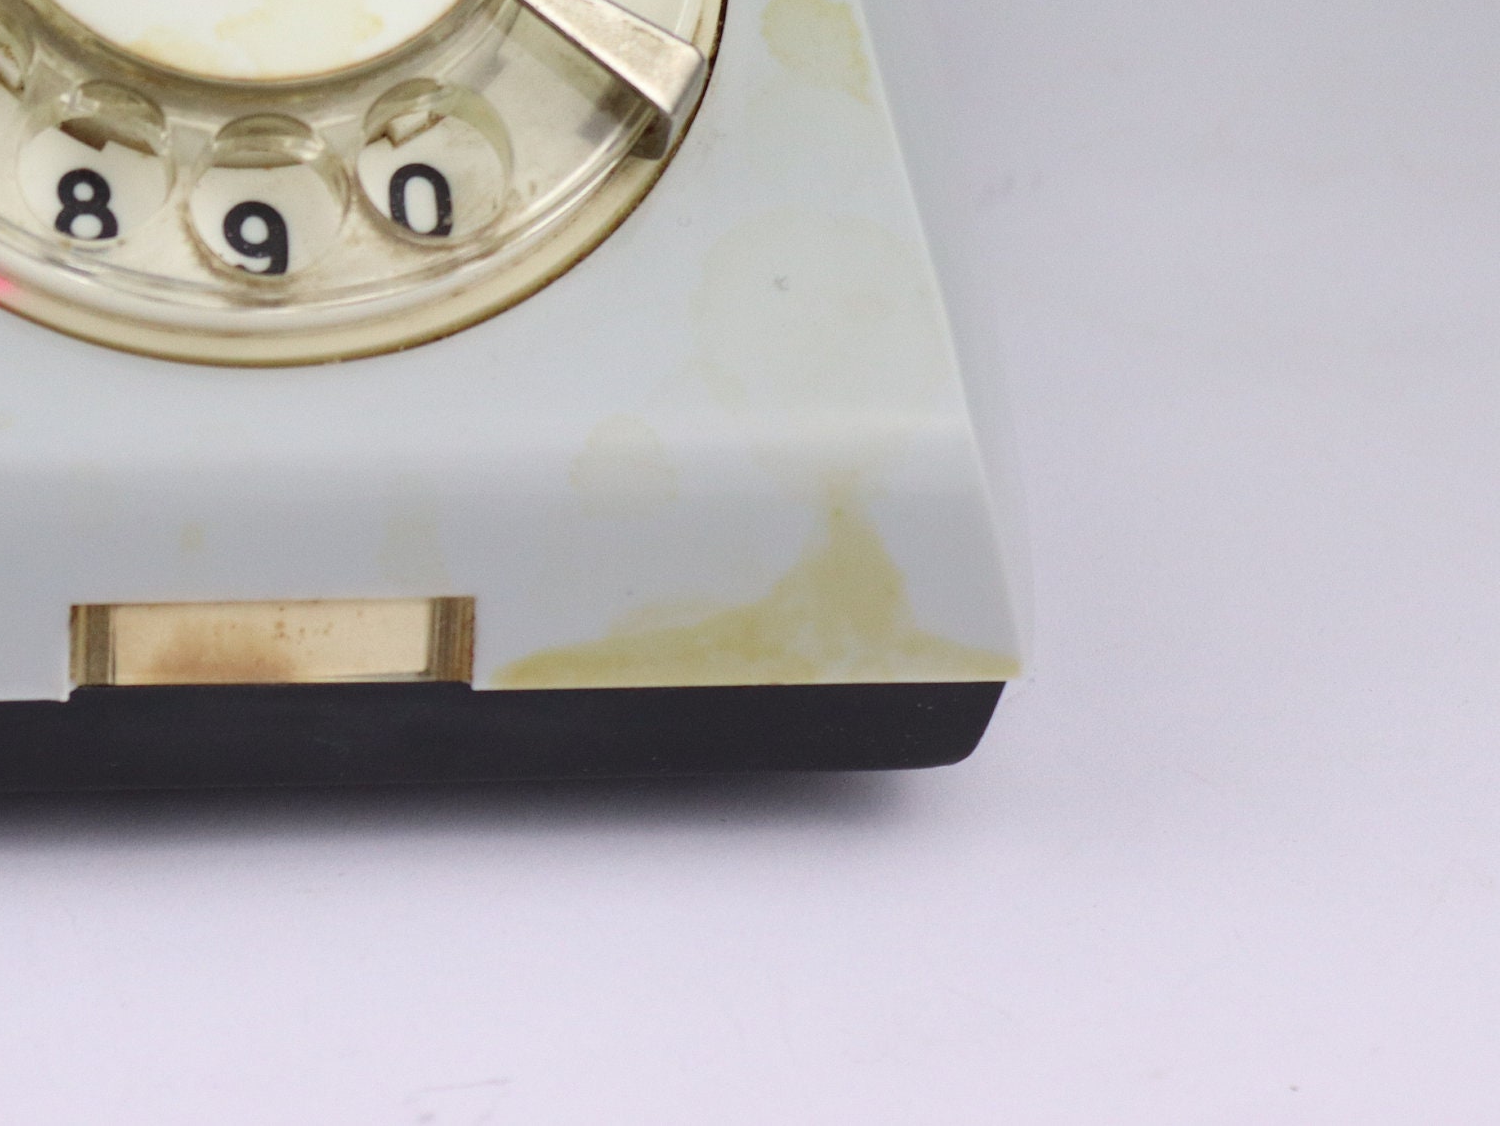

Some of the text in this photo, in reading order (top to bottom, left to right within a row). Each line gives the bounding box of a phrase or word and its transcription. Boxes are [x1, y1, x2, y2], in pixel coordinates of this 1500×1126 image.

[55, 167, 118, 240] 8
[223, 200, 289, 276] 9
[389, 163, 453, 238] 0
